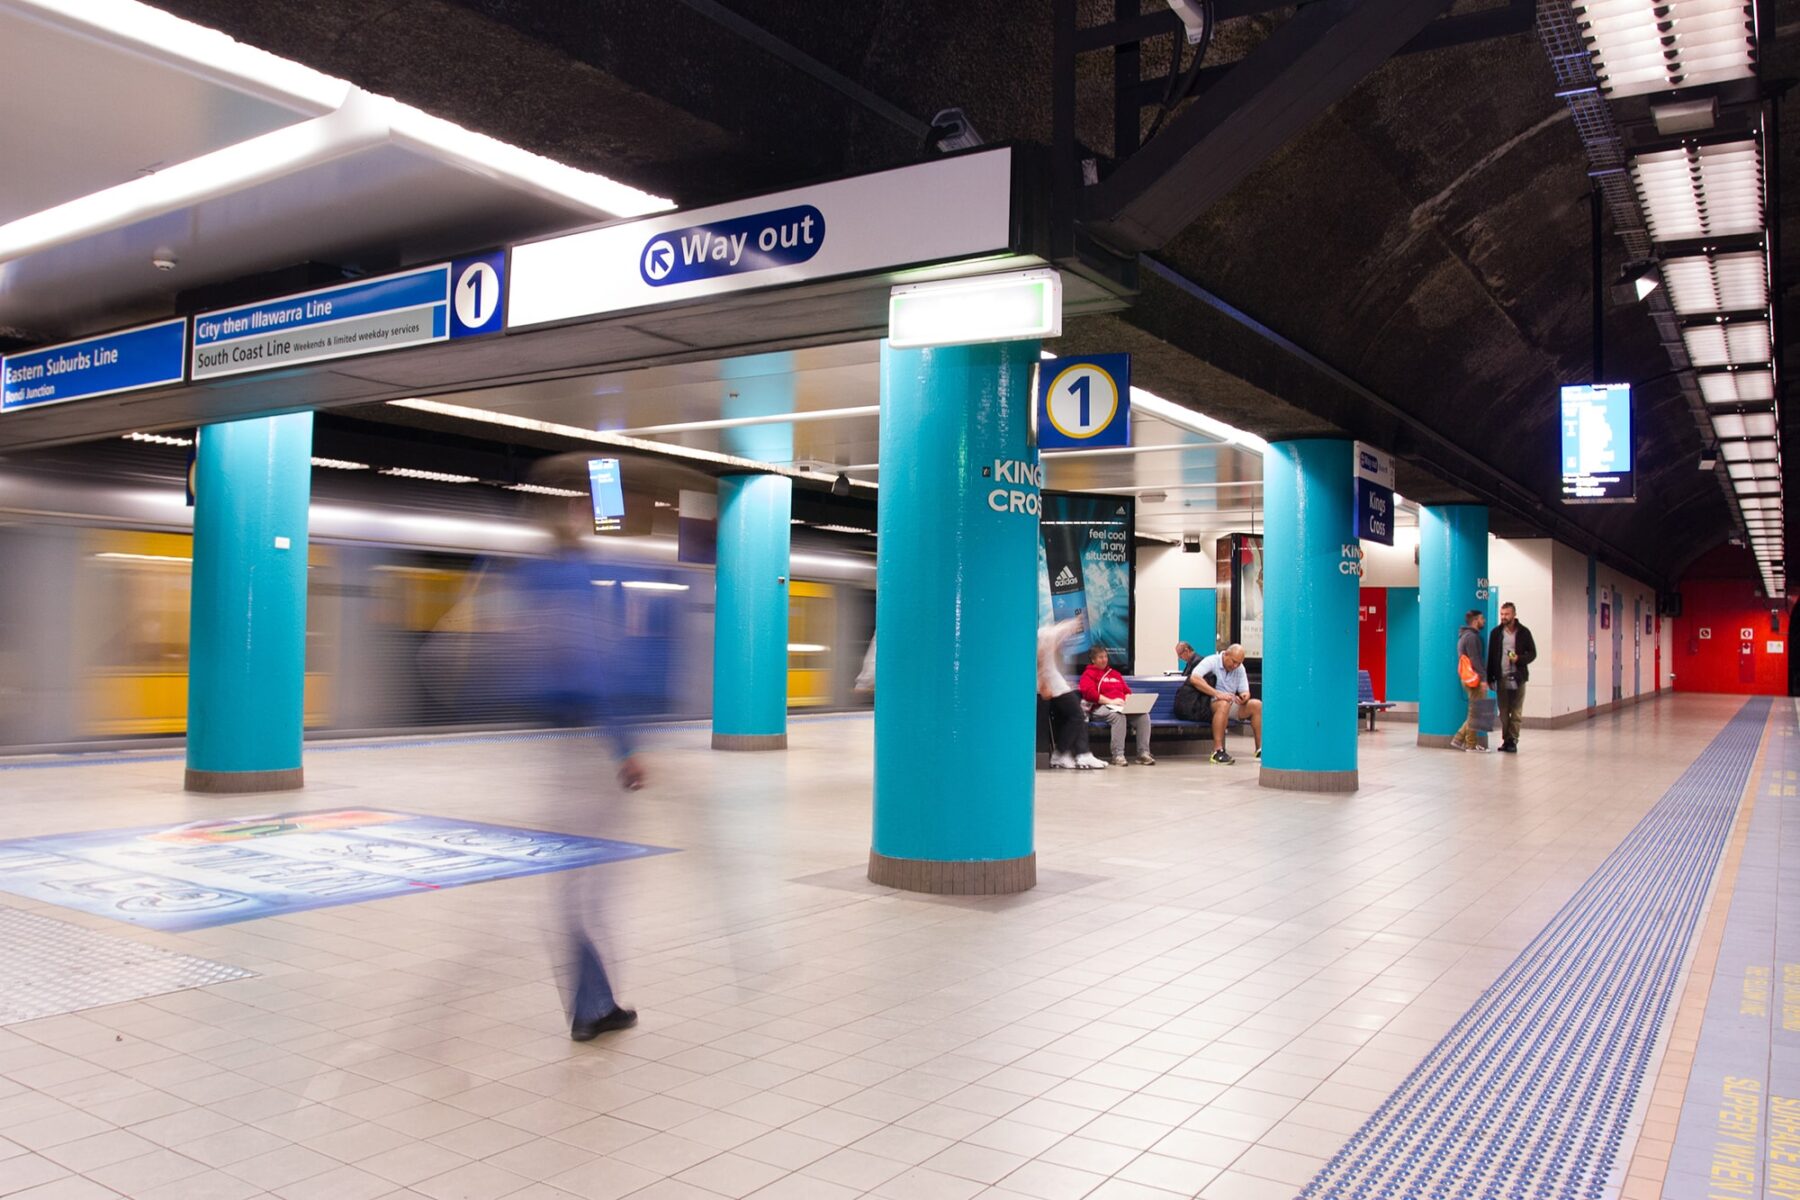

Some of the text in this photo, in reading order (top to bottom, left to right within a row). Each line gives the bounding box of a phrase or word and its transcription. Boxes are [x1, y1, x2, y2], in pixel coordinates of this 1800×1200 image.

[681, 214, 814, 267] Way out
[466, 268, 483, 320] 1
[199, 300, 332, 341] City then Illawarra Line
[5, 346, 118, 385] Eastern Suburbs Line
[198, 323, 420, 369] South Coast Line Weekends & limited weekday services
[5, 384, 55, 404] Bondi Junction
[1066, 375, 1090, 427] 1
[1369, 491, 1386, 517] Kings
[1089, 528, 1126, 541] feel cool
[1369, 514, 1386, 536] Cross
[1085, 551, 1126, 562] situation!
[1100, 540, 1126, 553] in any
[1055, 577, 1077, 587] adidas
[1717, 1076, 1761, 1143] SLIPPERY
[1709, 1142, 1756, 1195] WHEN
